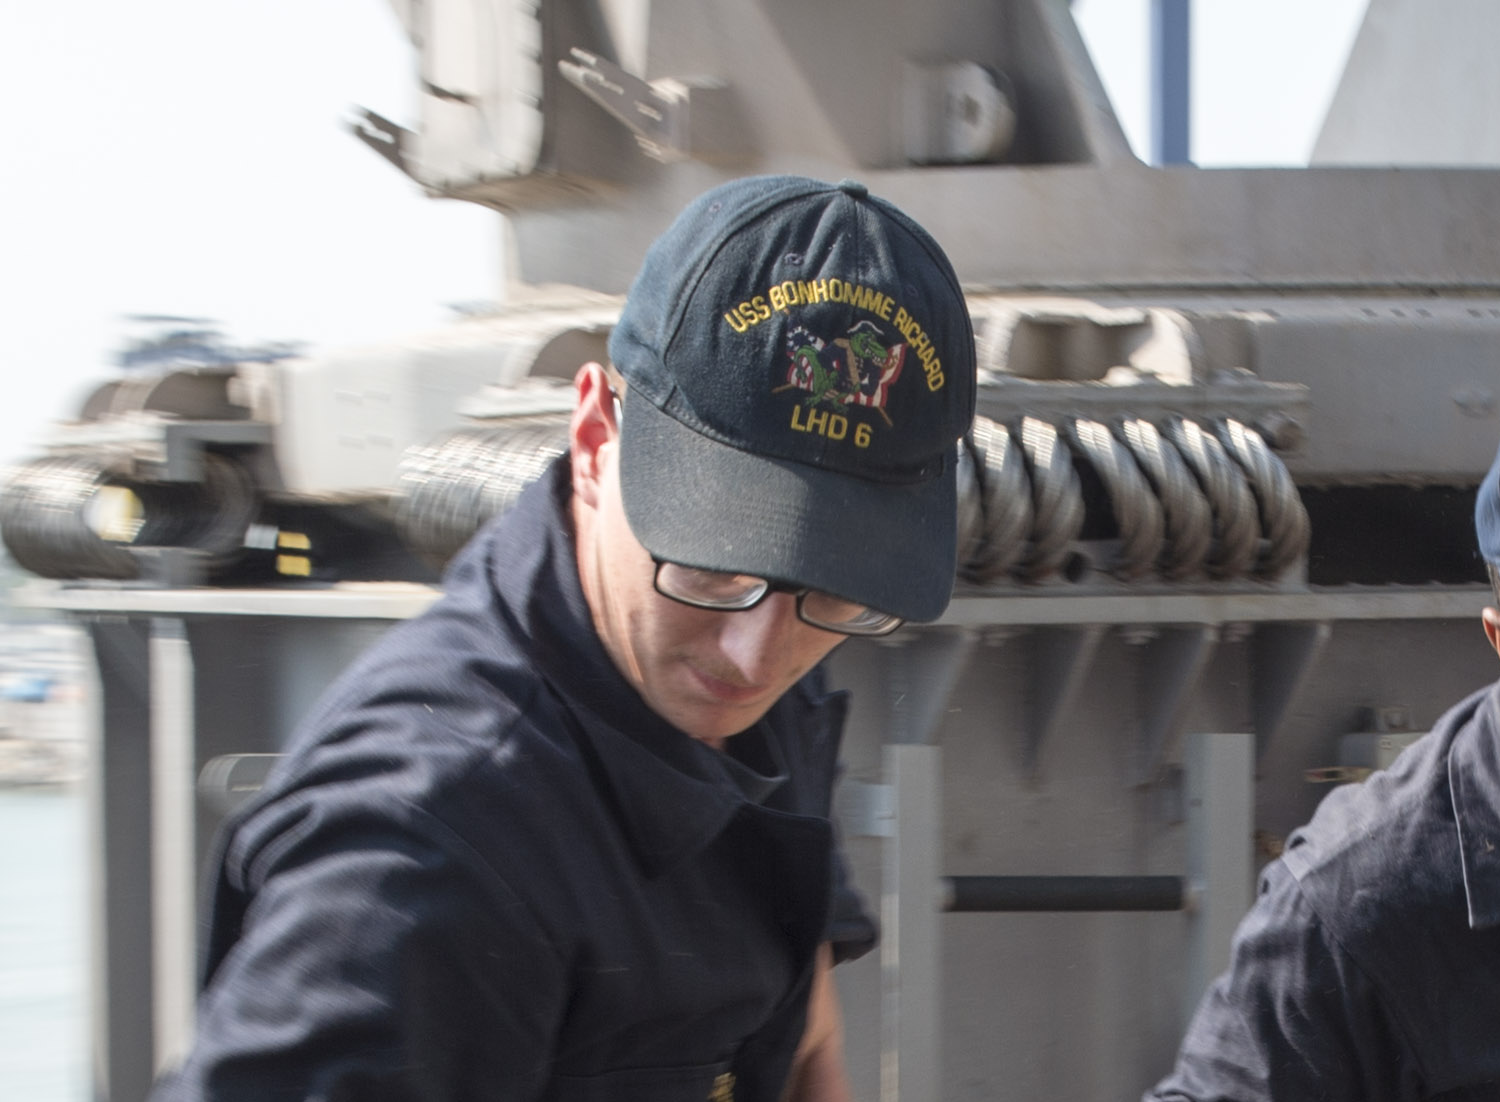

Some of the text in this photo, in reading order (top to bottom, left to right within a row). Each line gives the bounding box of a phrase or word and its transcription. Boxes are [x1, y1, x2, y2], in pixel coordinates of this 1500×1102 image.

[723, 278, 944, 392] USS BONHOMME RICHARD
[791, 404, 873, 448] LHD 6
